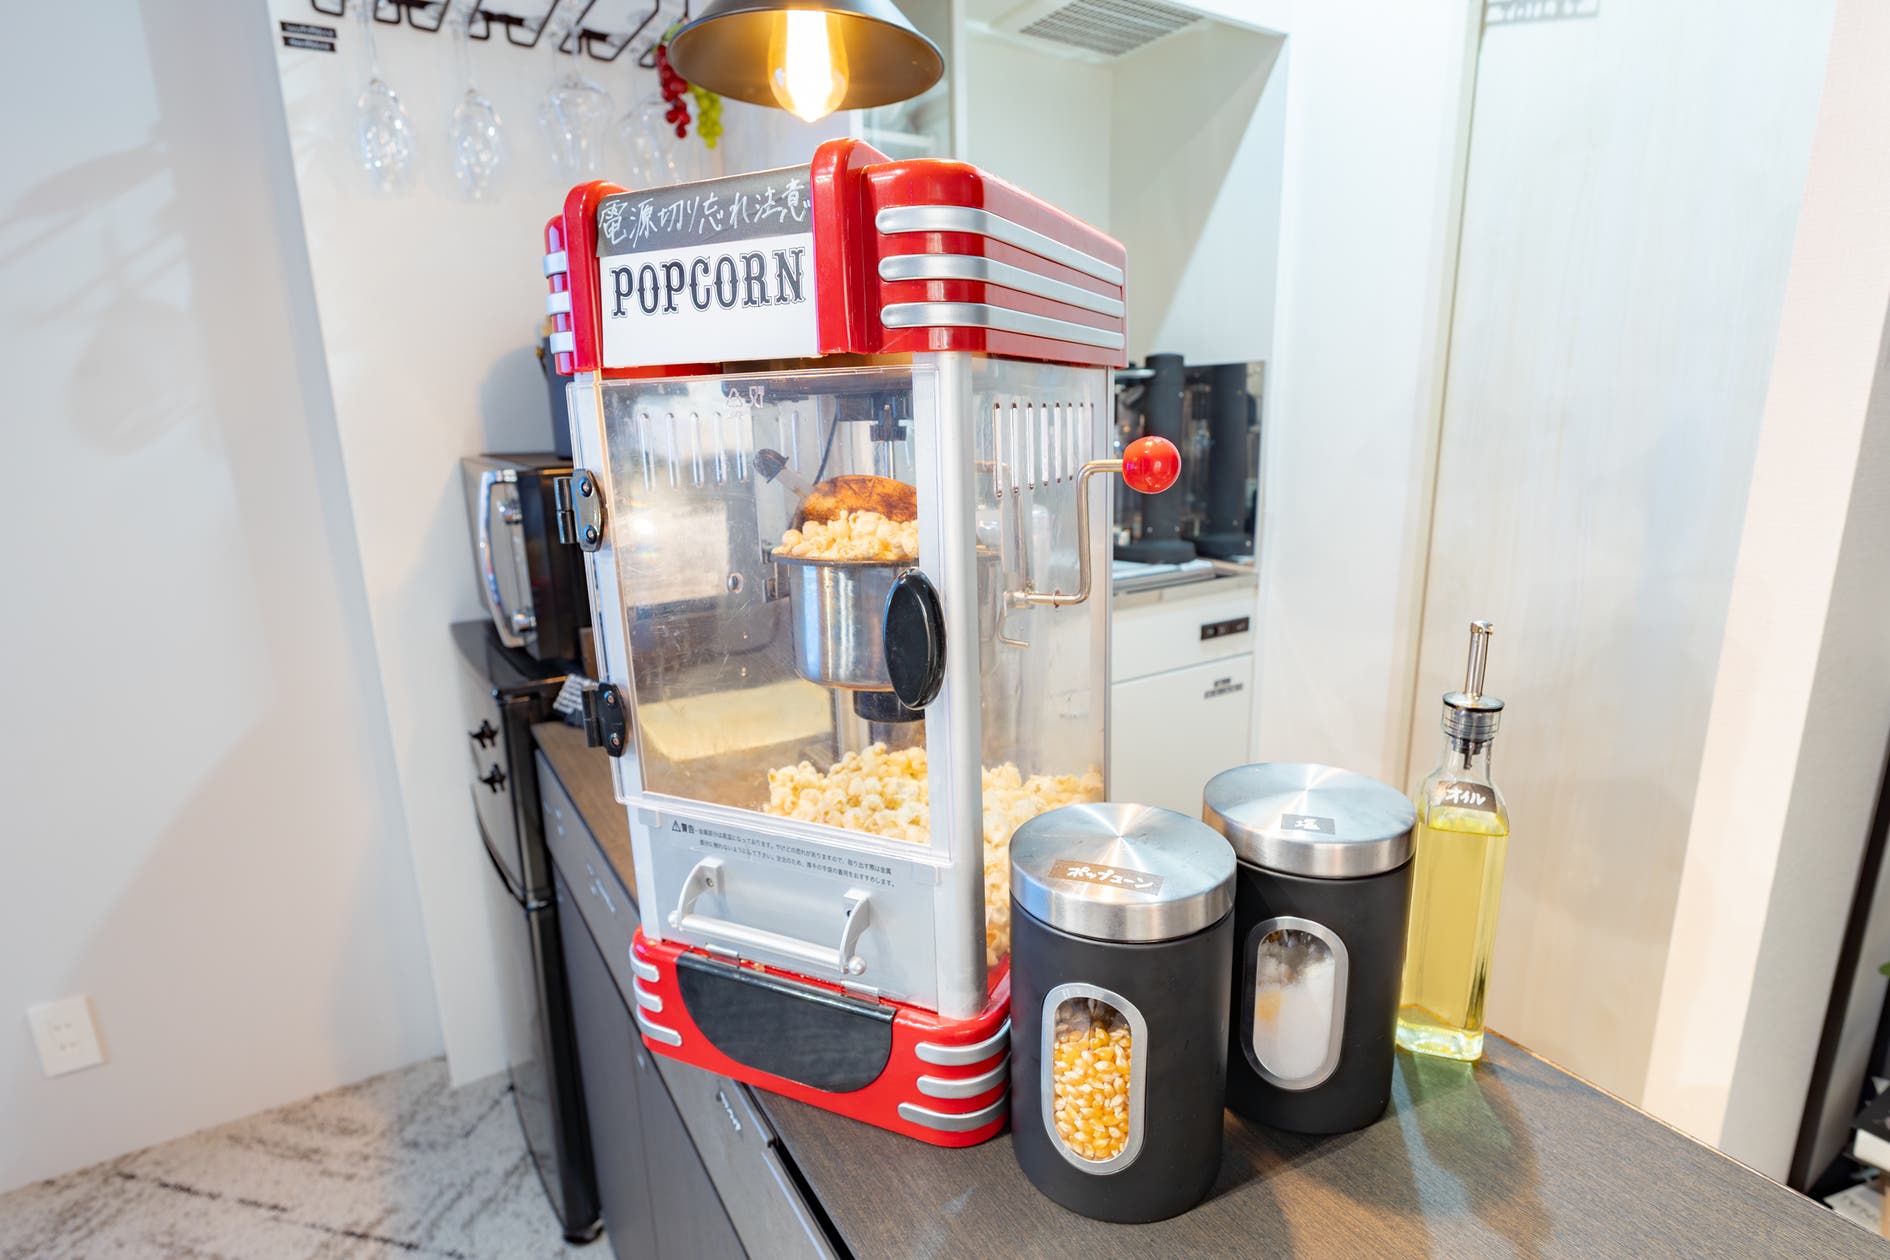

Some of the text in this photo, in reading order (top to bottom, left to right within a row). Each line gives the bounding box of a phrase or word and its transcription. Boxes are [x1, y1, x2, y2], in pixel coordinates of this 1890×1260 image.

[598, 178, 812, 248] 電源切り忘れ注意
[609, 247, 806, 319] POPCORN
[1445, 787, 1486, 806] オイル
[1066, 866, 1154, 889] ポップコーン
